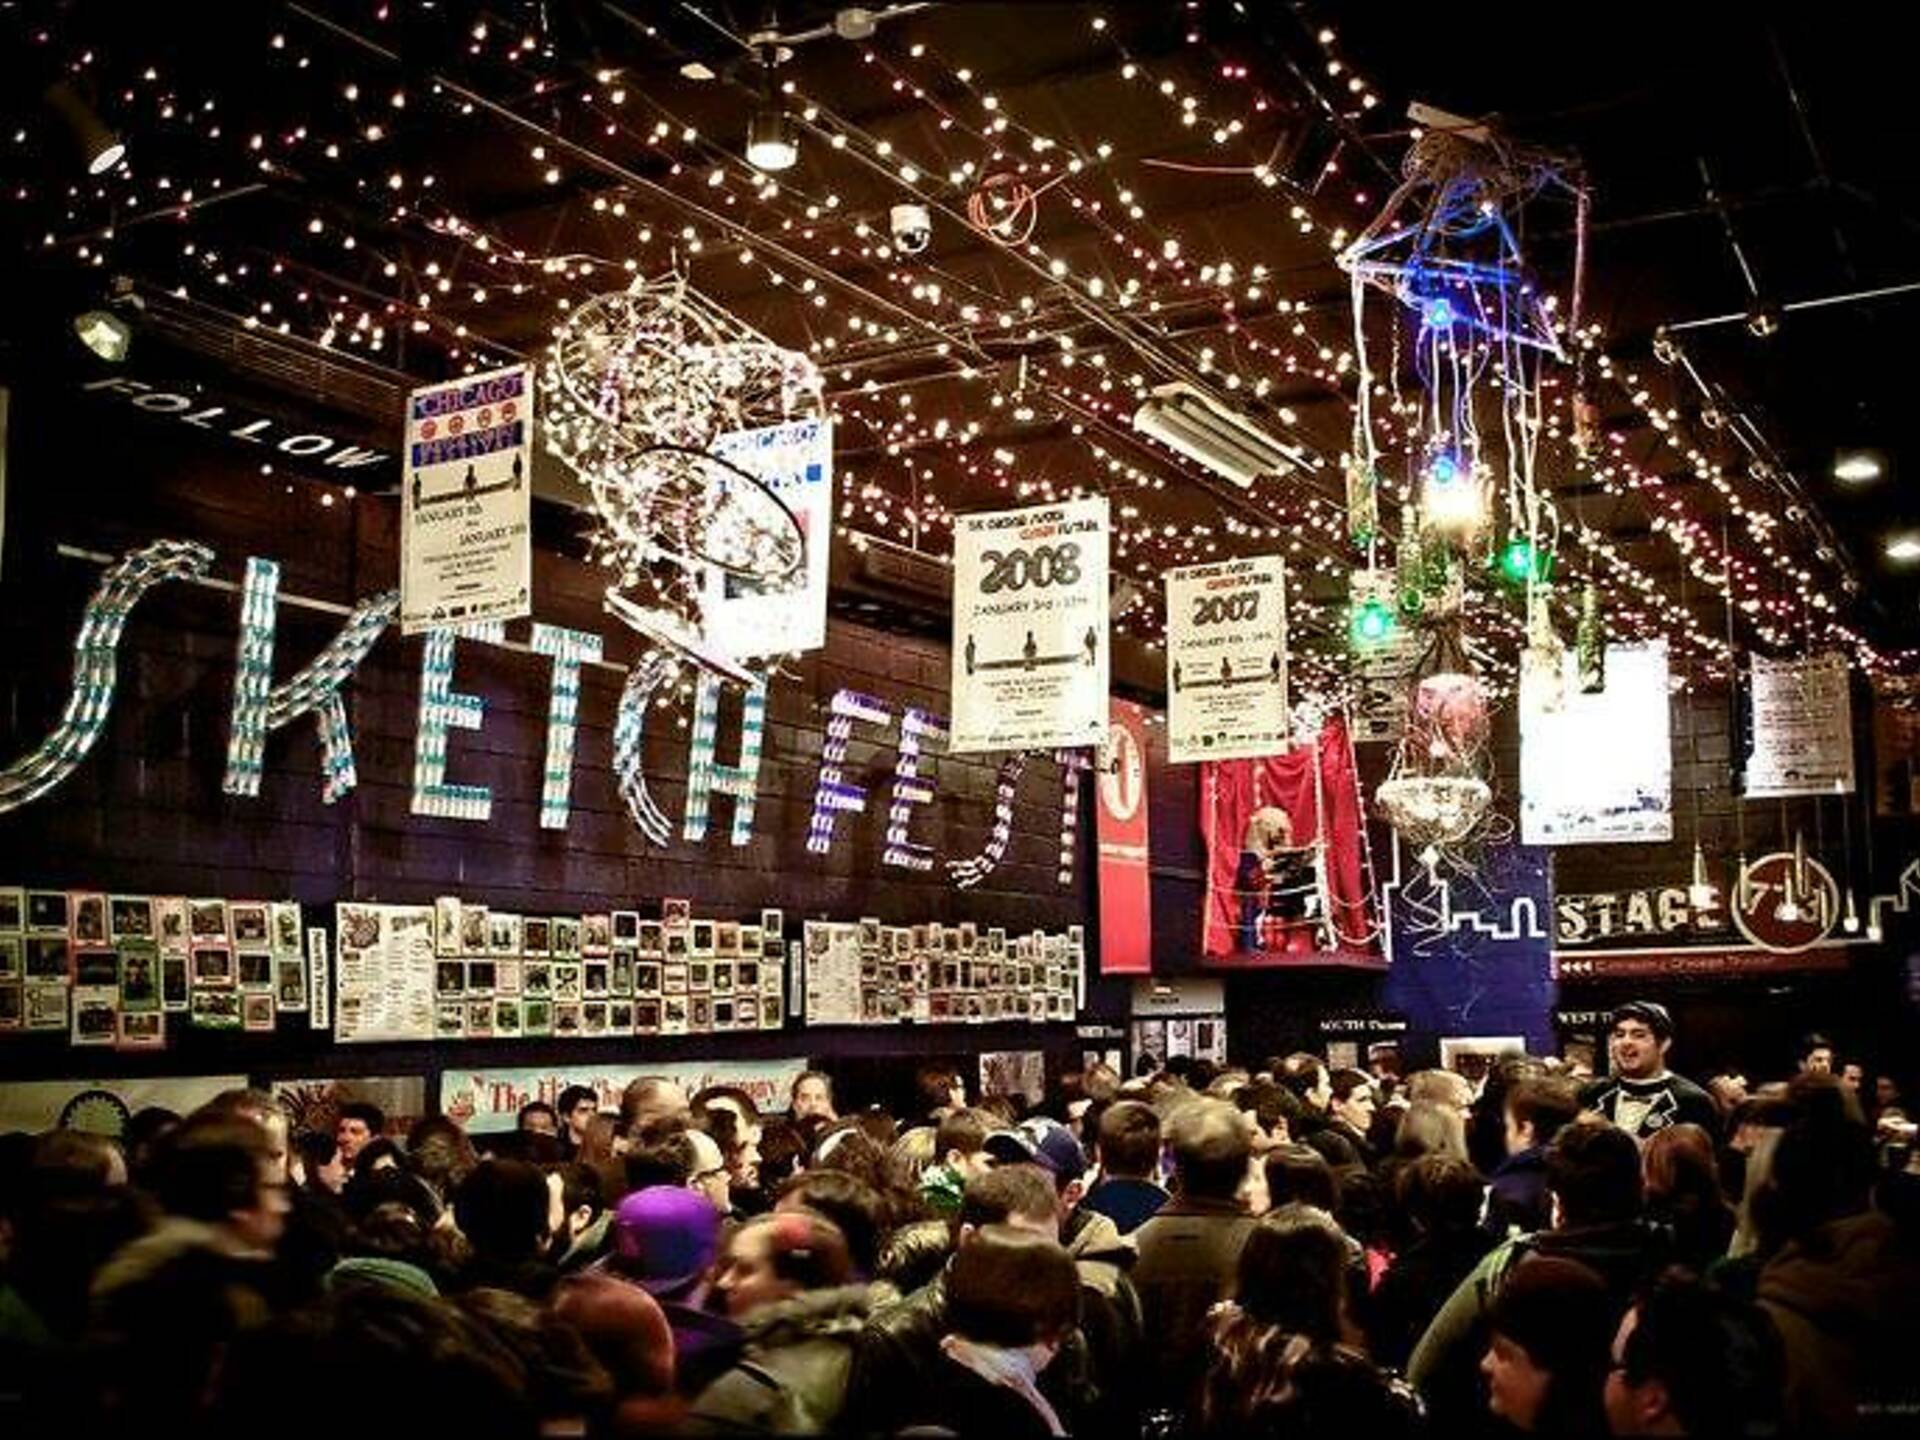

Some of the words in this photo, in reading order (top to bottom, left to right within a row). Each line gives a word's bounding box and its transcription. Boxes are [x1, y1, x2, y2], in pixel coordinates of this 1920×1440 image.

[83, 376, 391, 468] FOLLOW
[979, 541, 1081, 595] 2008
[1191, 590, 1261, 627] 2007
[1556, 884, 1721, 942] STAGE
[1558, 1012, 1596, 1024] WEST
[488, 1080, 531, 1114] The
